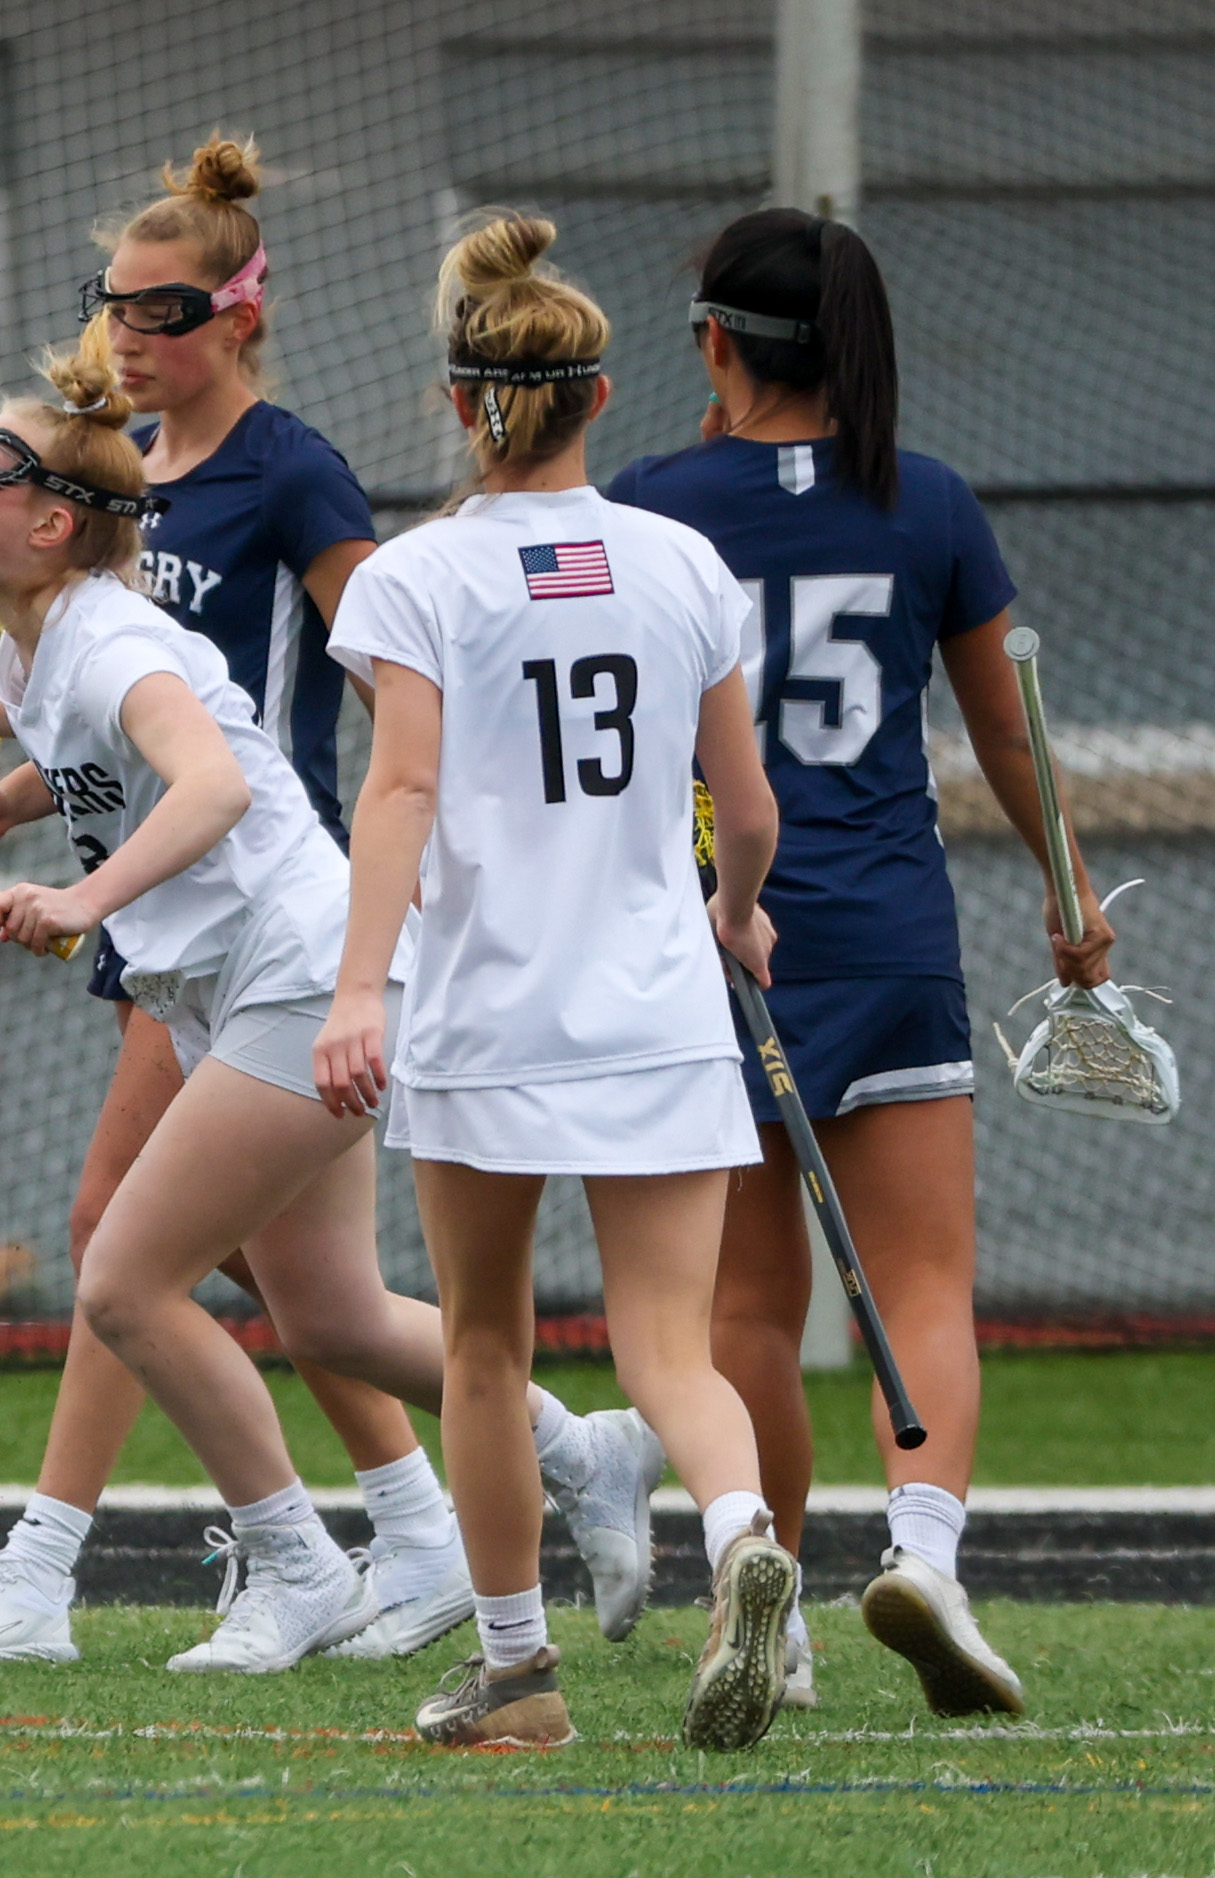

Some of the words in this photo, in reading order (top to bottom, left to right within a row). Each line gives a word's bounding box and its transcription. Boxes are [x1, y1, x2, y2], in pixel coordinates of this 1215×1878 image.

[44, 474, 95, 505] STX
[135, 549, 223, 616] GRY
[522, 653, 638, 804] 13
